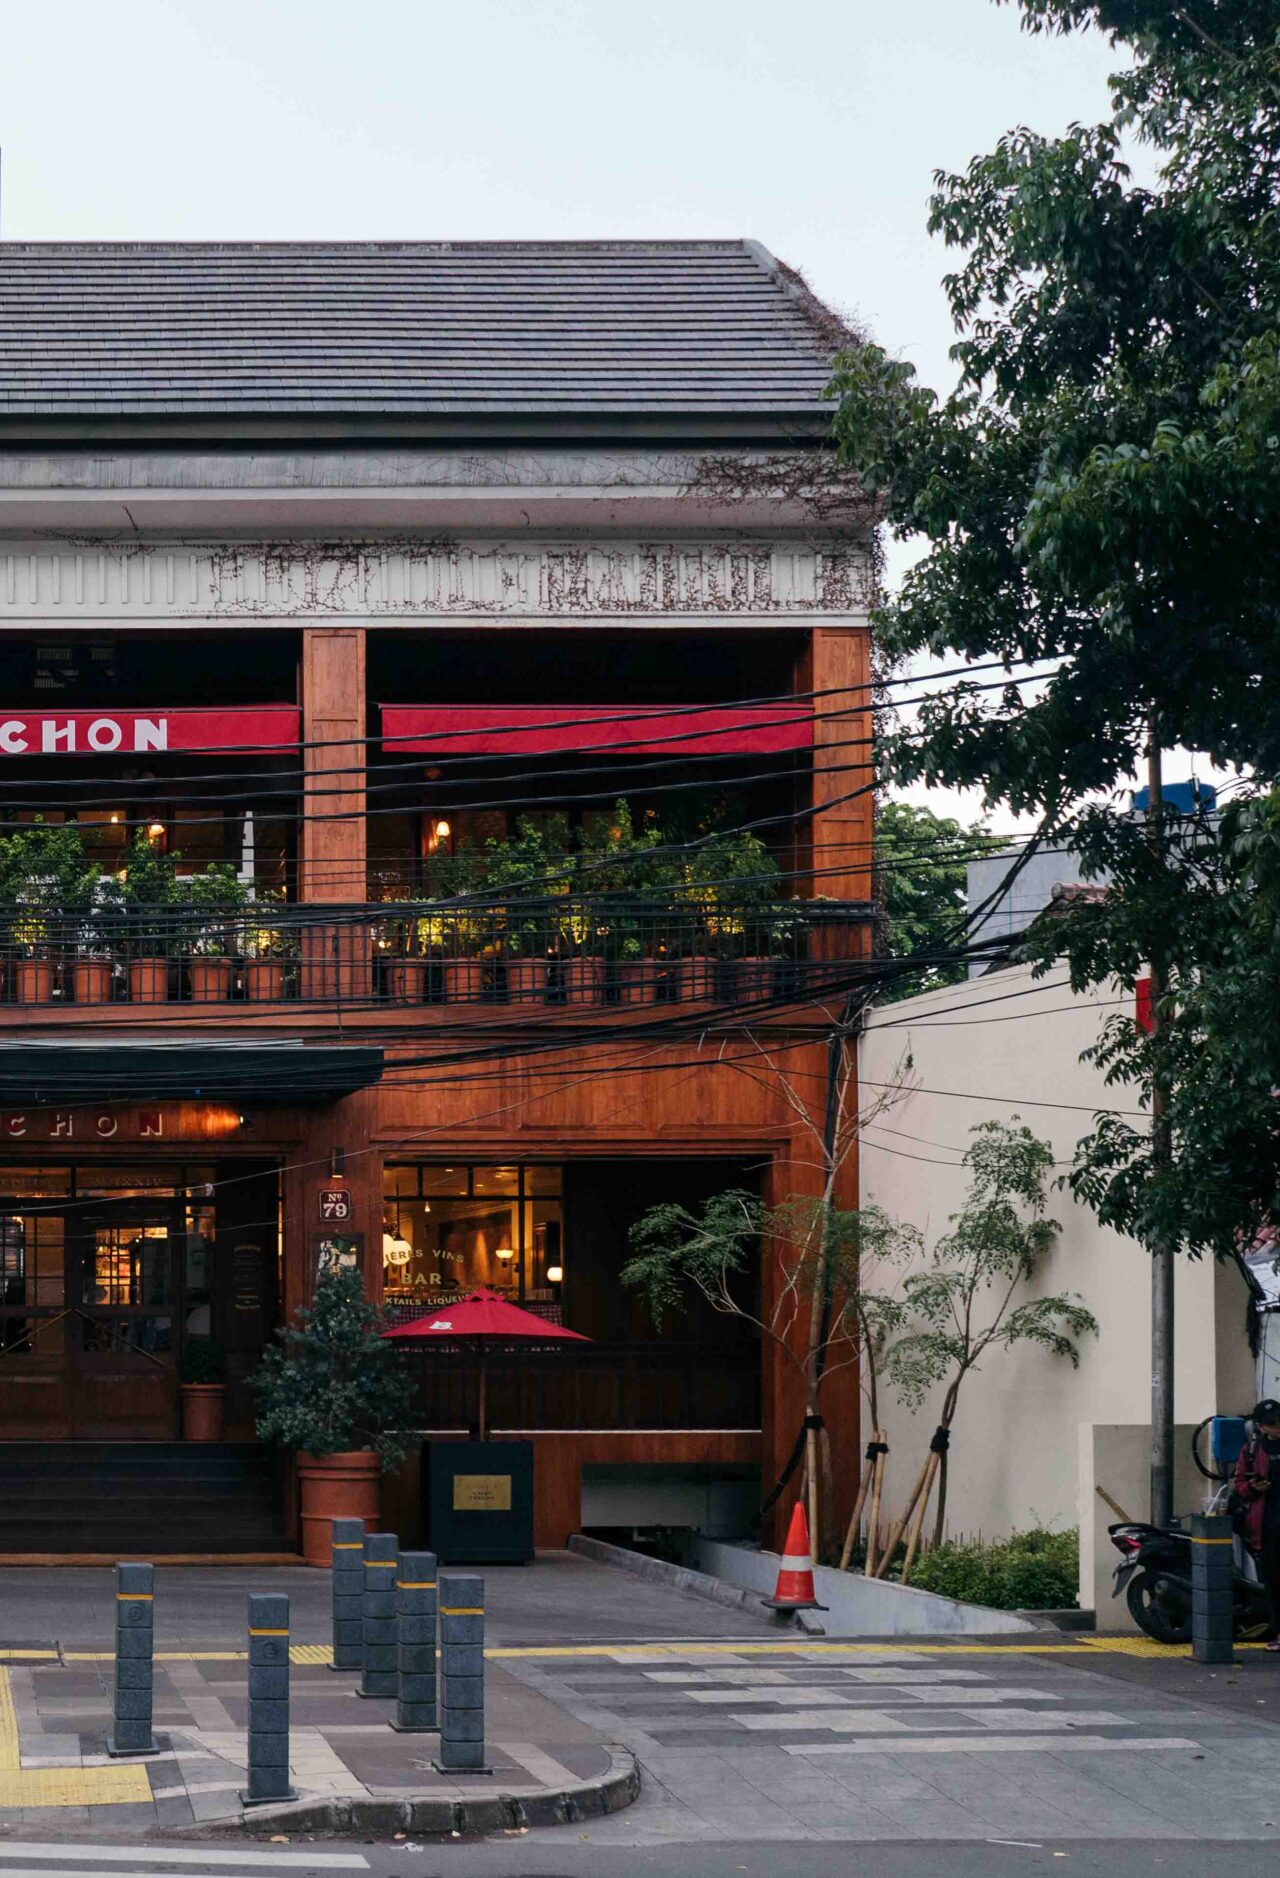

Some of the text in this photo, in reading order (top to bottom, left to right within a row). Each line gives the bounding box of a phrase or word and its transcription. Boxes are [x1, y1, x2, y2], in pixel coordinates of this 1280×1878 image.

[323, 1203, 348, 1218] 79
[384, 1249, 465, 1265] IÈRES VINS
[401, 1273, 442, 1285] BAR
